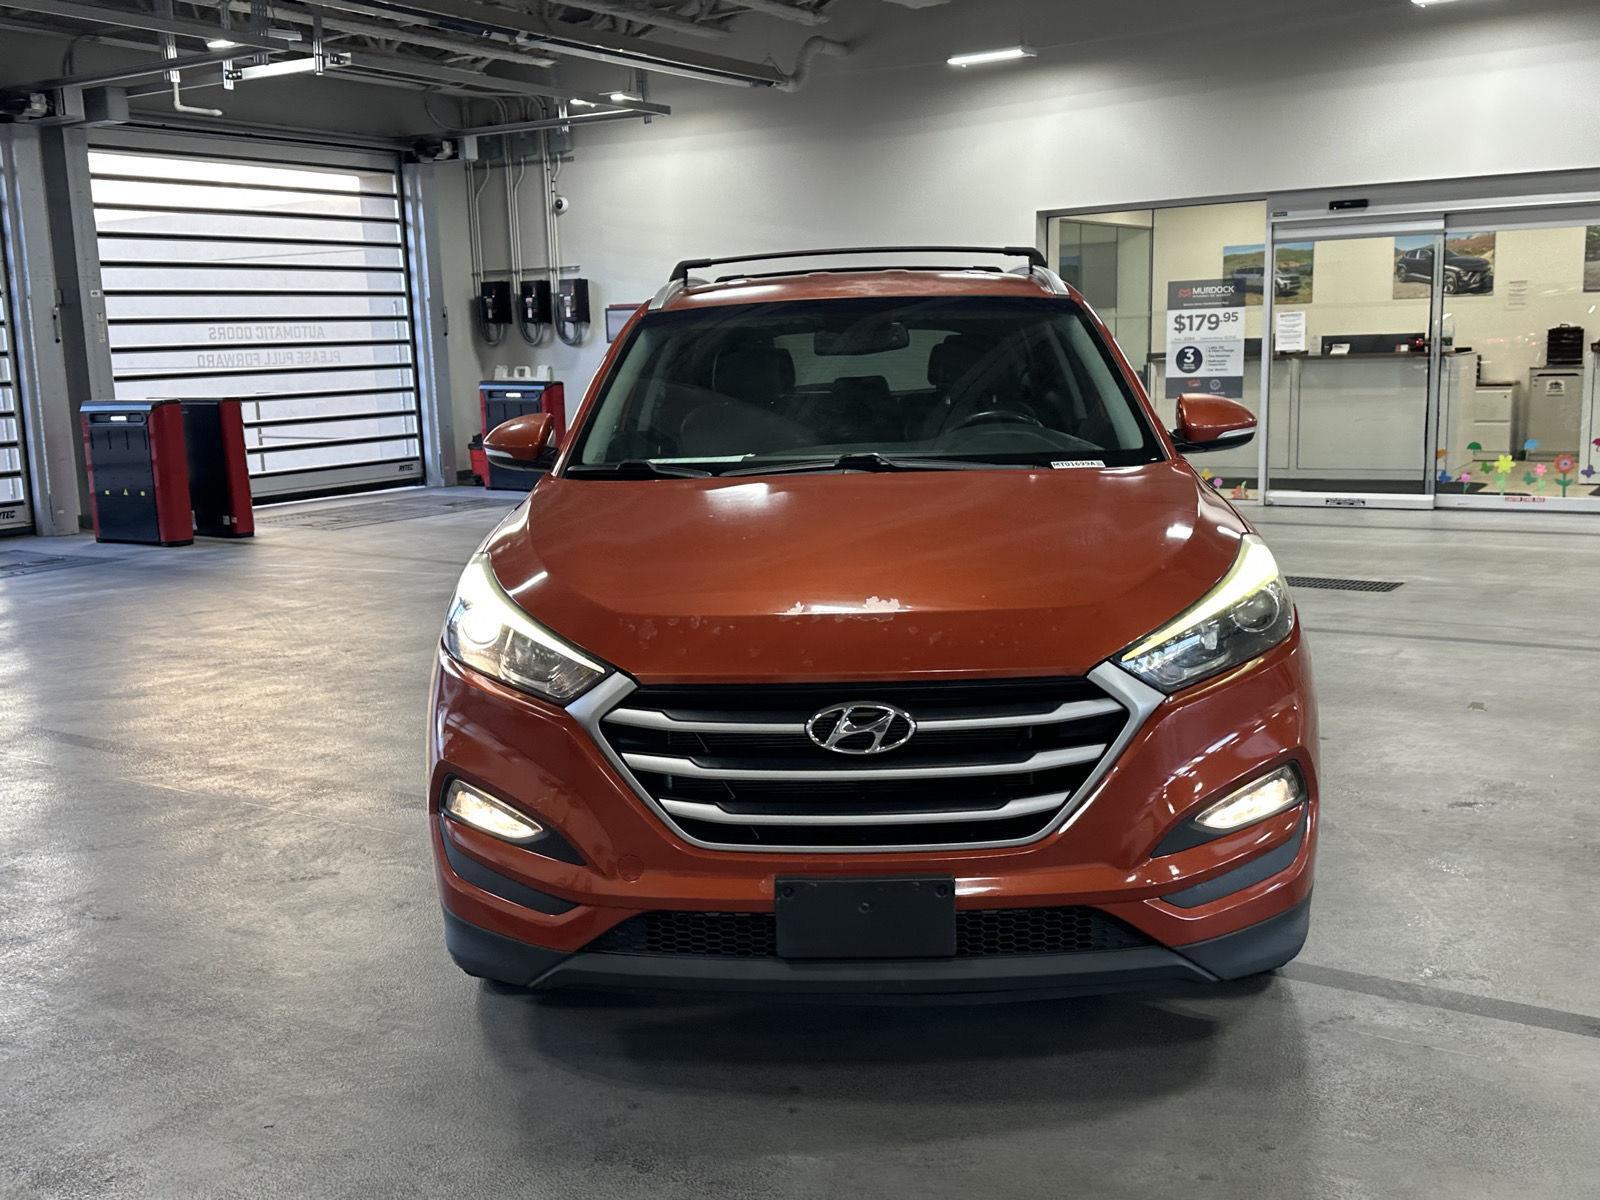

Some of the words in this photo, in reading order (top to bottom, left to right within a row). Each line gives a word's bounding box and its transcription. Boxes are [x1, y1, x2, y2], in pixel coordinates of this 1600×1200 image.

[1192, 285, 1235, 295] MURDOCK
[1174, 312, 1239, 334] $179.95
[1183, 348, 1195, 363] 3
